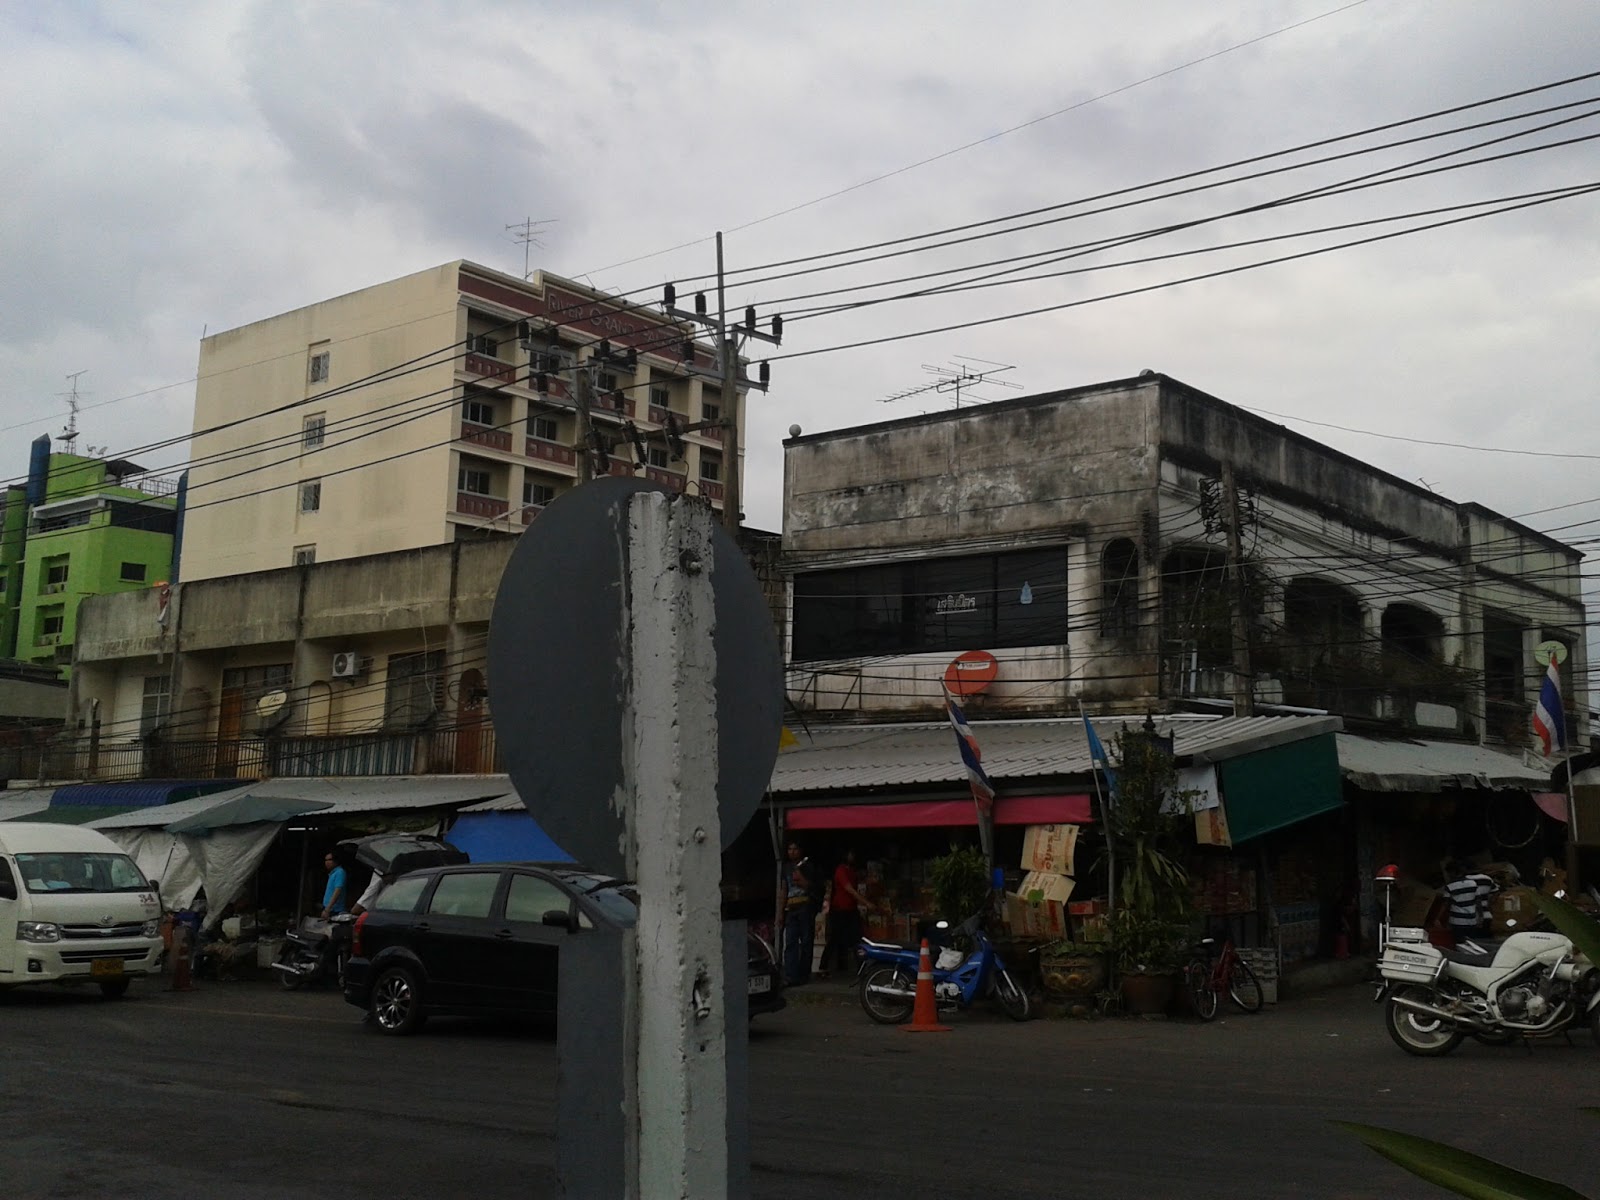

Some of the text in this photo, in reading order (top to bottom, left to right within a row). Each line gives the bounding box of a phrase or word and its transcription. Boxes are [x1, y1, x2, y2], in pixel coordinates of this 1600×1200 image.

[548, 293, 583, 320] RIVER
[590, 307, 635, 337] GRAND
[1393, 954, 1427, 964] POLICE
